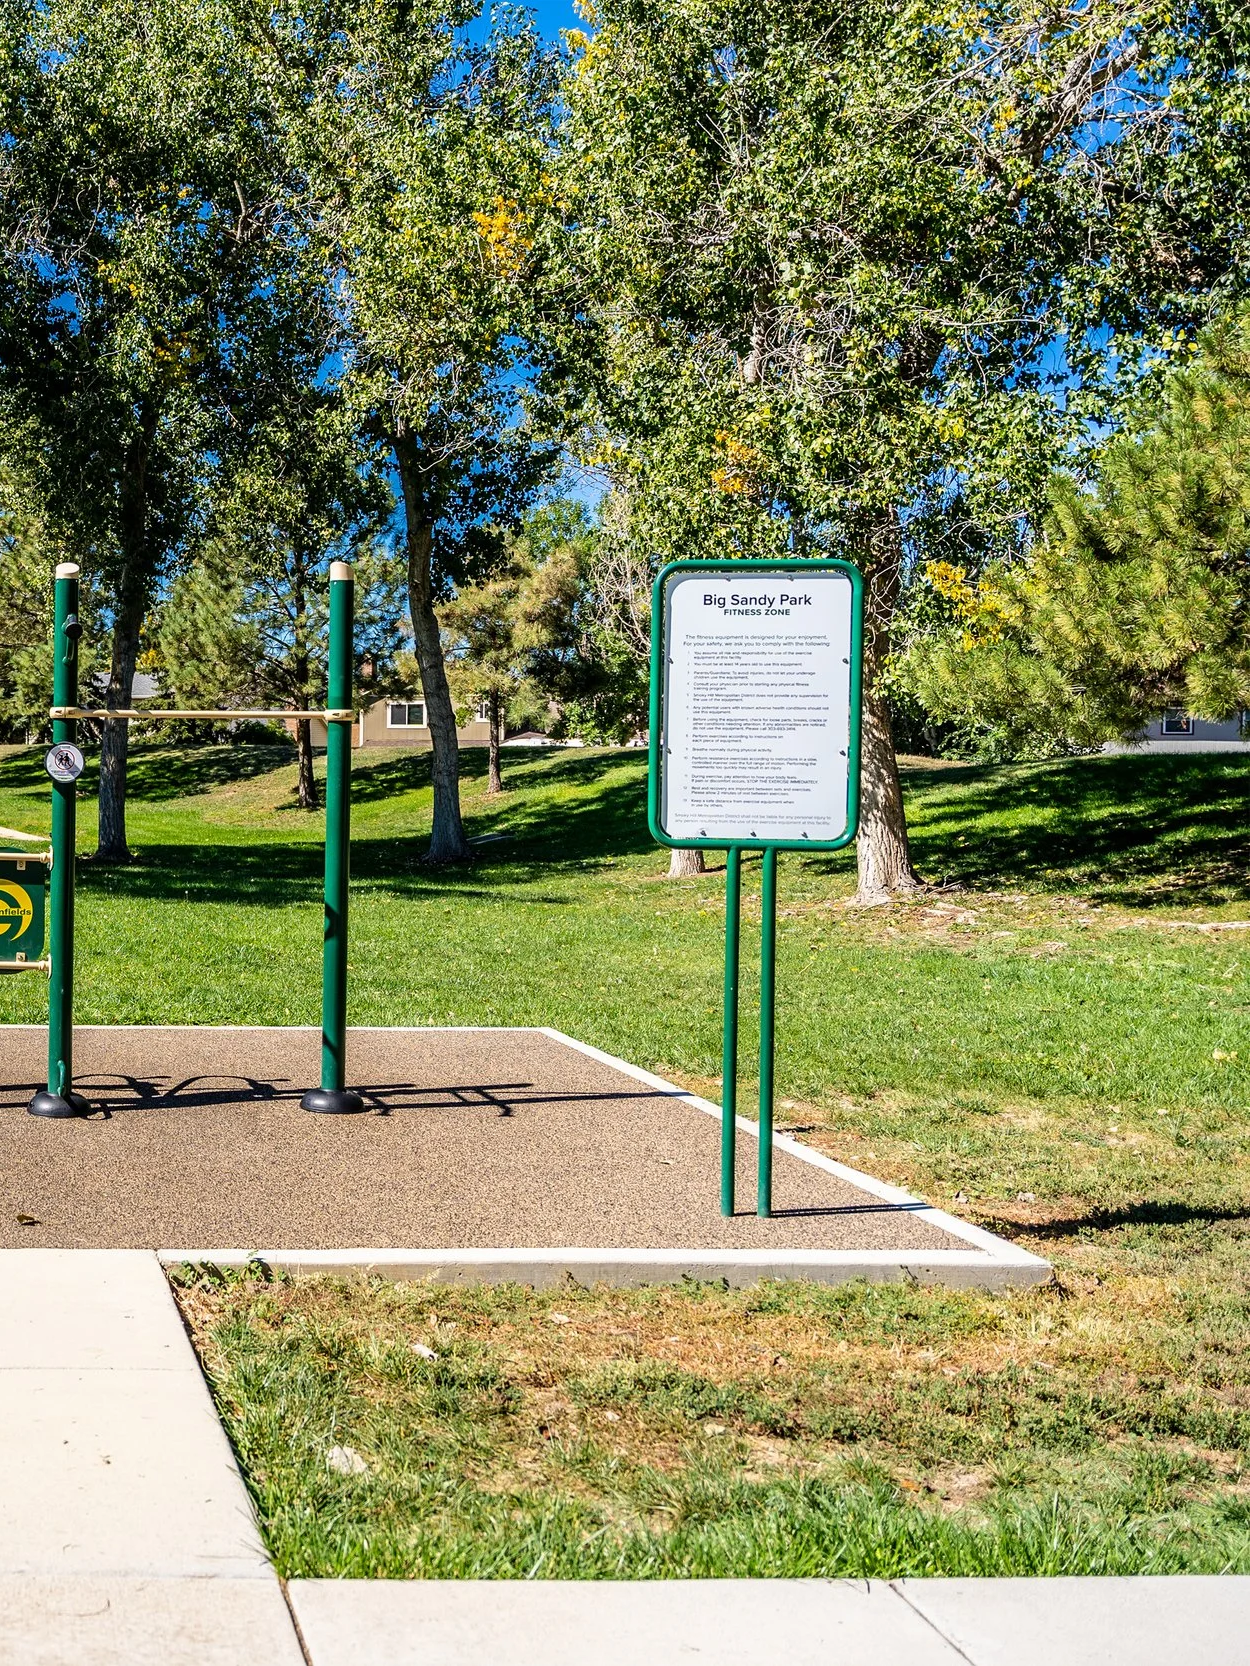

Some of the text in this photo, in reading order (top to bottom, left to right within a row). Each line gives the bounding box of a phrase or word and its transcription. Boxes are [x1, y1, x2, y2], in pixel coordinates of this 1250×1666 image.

[703, 594, 812, 609] Big Sandy Park
[723, 608, 791, 616] FITNESS ZONE
